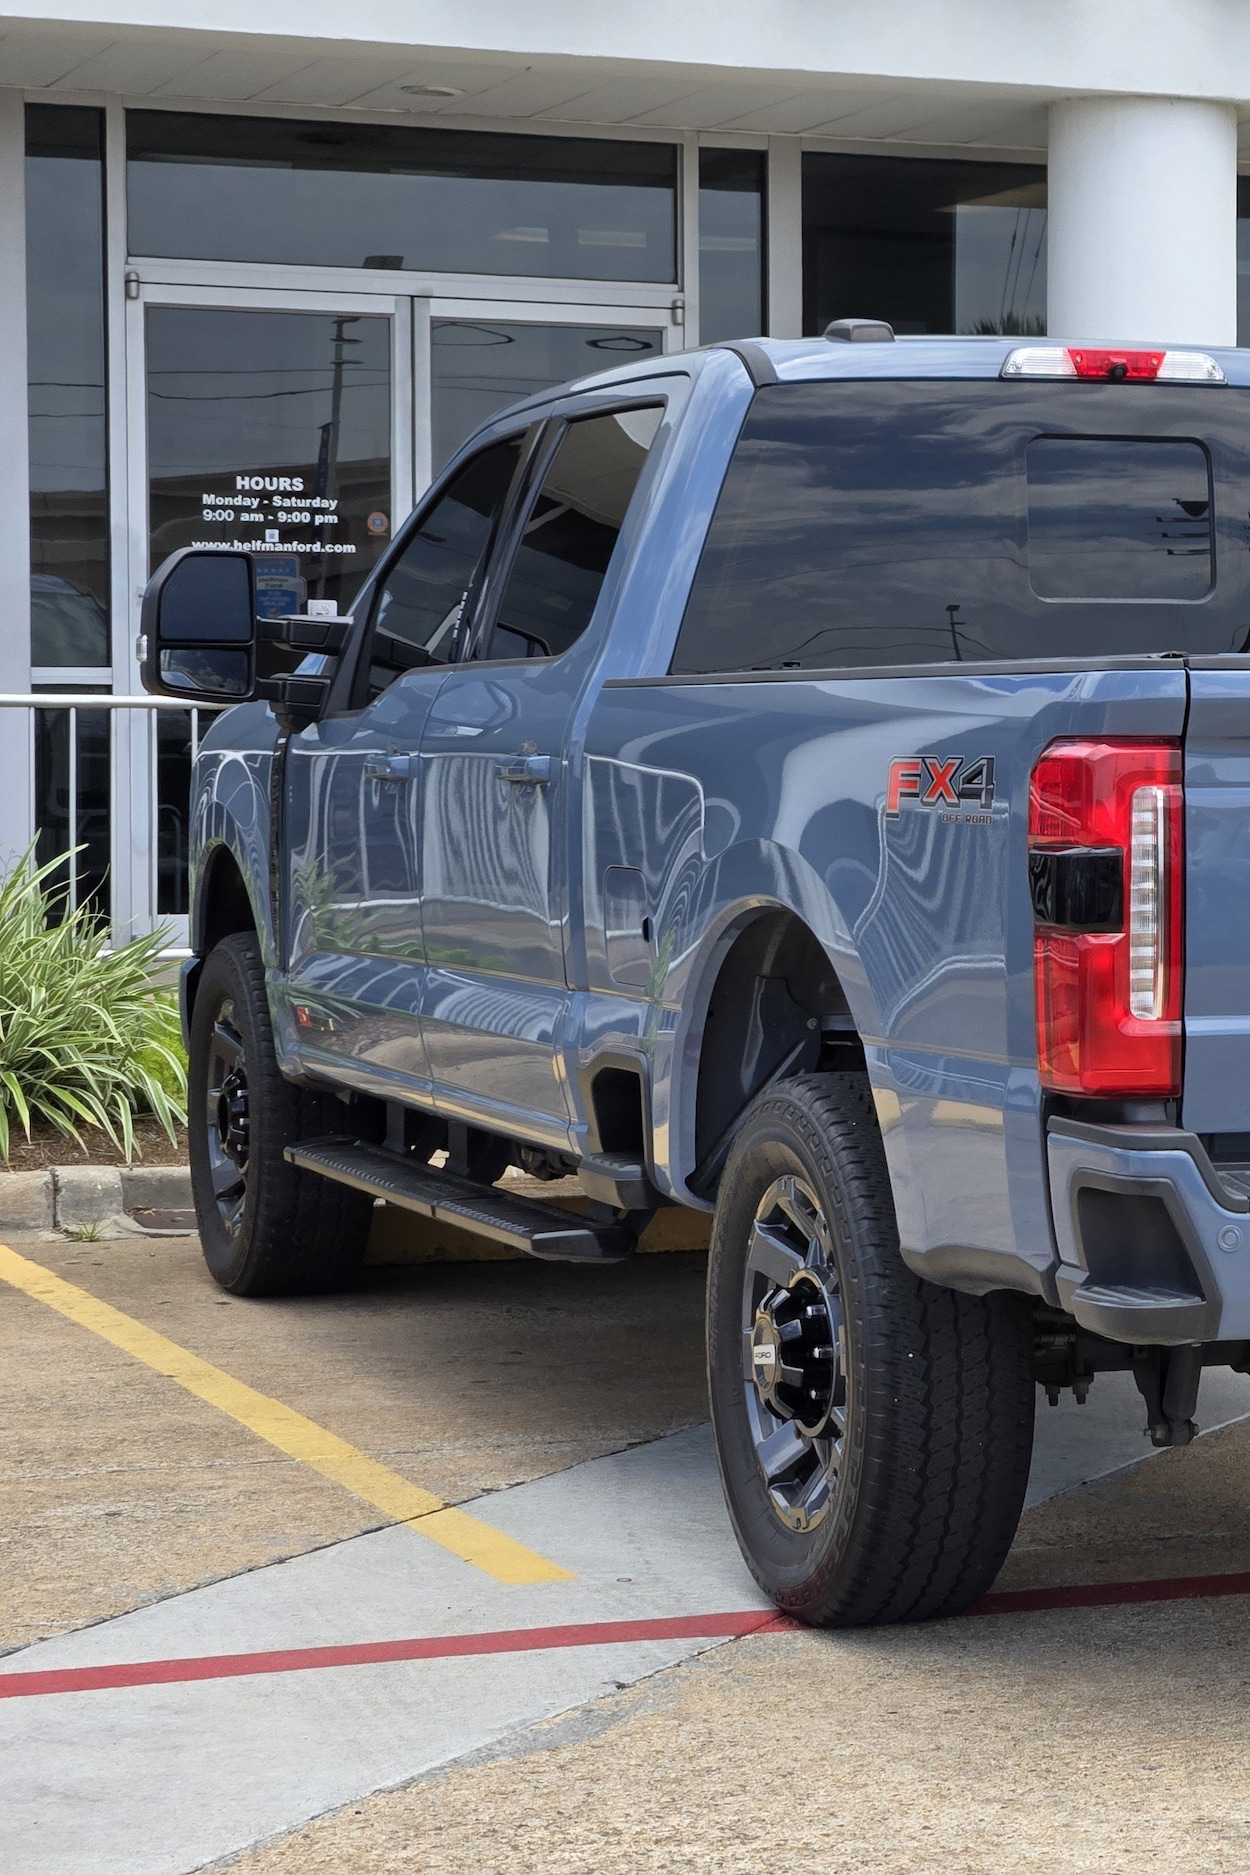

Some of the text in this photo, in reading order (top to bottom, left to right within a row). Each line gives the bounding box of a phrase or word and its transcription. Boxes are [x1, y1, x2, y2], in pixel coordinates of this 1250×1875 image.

[236, 475, 304, 491] HOURS
[202, 494, 260, 509] Monday
[272, 495, 338, 510] Saturday
[202, 509, 235, 522] 9:00
[240, 512, 264, 522] am
[278, 511, 311, 523] 9:00
[315, 512, 338, 526] pm
[191, 539, 356, 554] www.helfmanford.com
[885, 754, 996, 821] FX4
[942, 813, 993, 825] OFF ROAD
